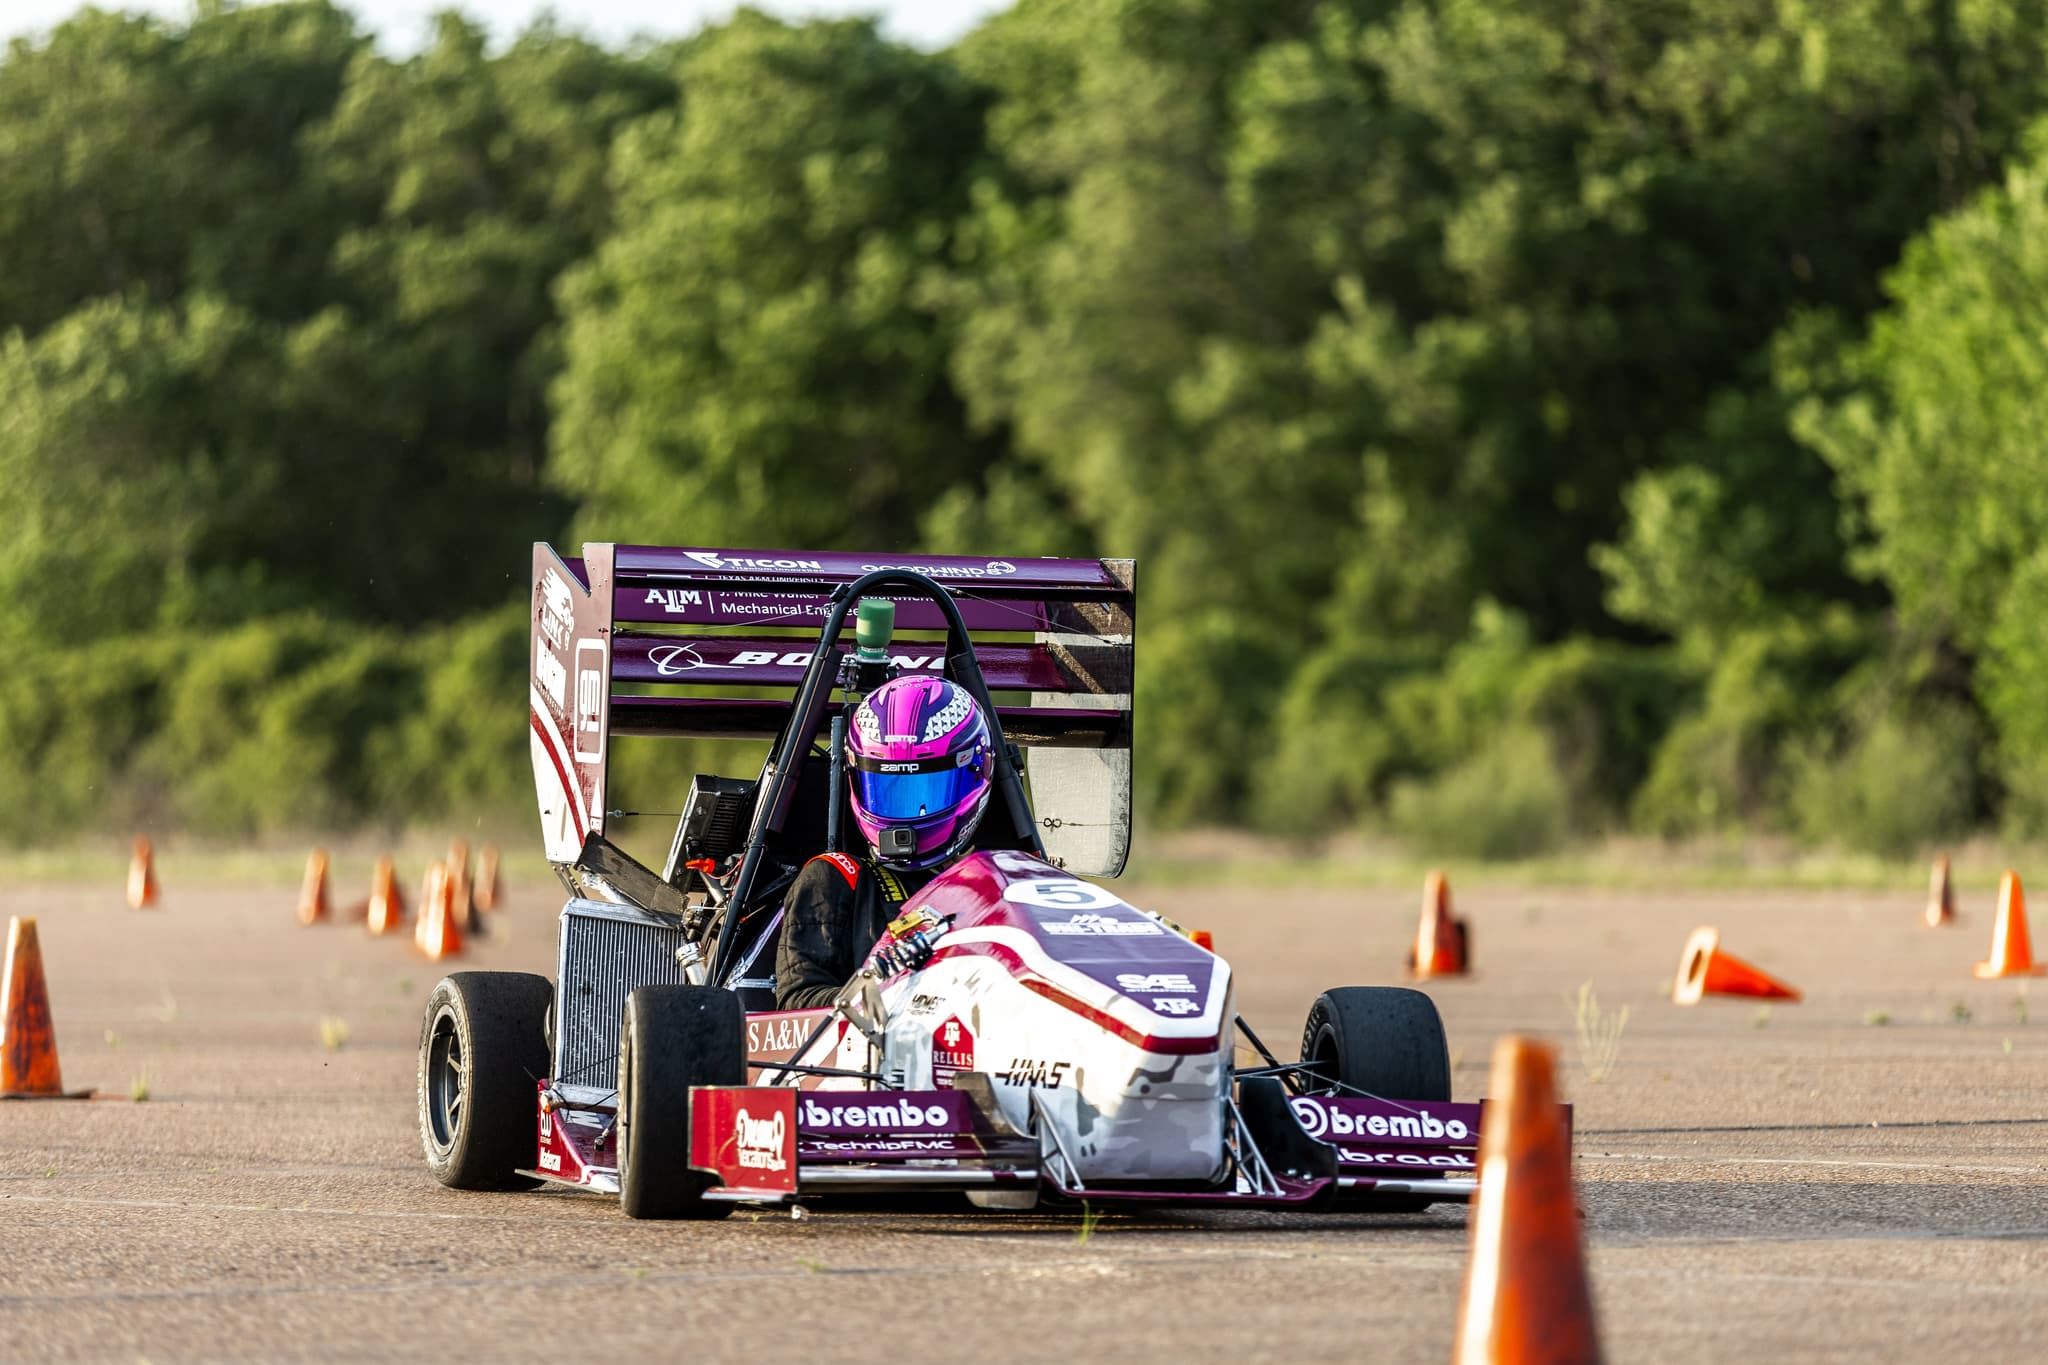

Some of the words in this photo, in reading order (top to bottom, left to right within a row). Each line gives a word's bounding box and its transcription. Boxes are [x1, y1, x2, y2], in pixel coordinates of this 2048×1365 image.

[723, 558, 822, 569] TICON
[722, 602, 801, 615] Mechanical
[880, 763, 920, 773] zamp
[1035, 884, 1097, 904] 5
[1116, 974, 1196, 989] SAE
[762, 1018, 810, 1051] A&M
[933, 1051, 973, 1066] RELLIS
[806, 1099, 949, 1128] brembo
[1331, 1105, 1468, 1139] brembo
[810, 1140, 955, 1151] TechnipFMC
